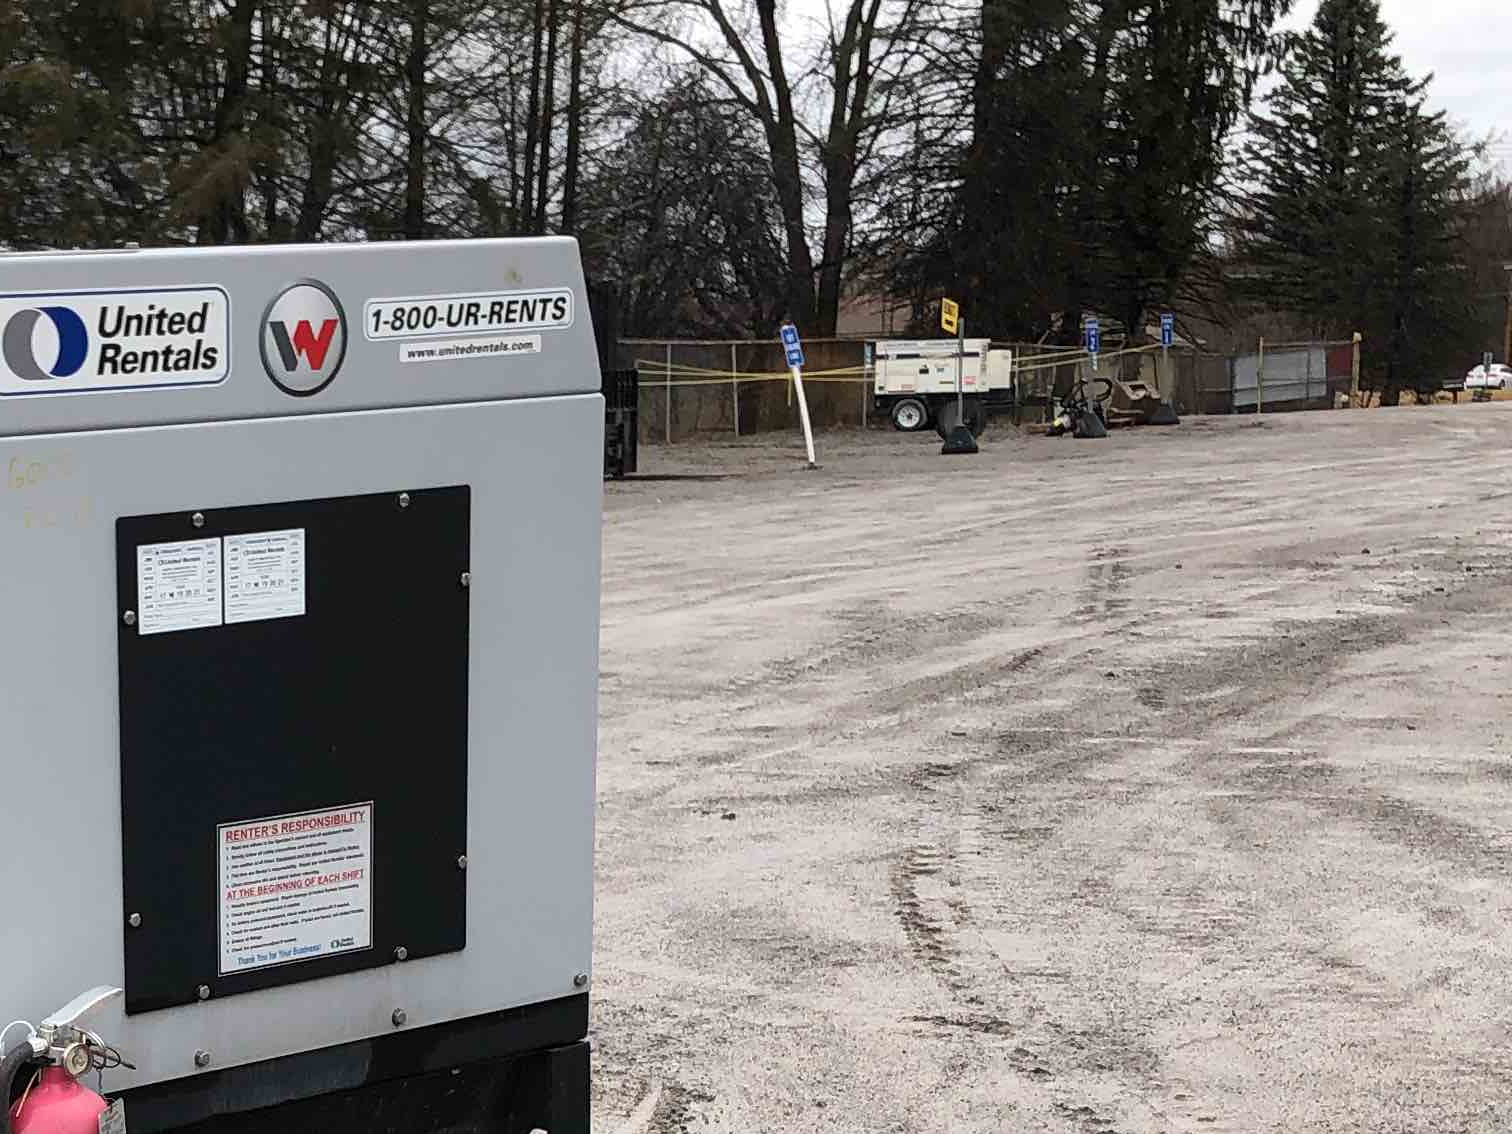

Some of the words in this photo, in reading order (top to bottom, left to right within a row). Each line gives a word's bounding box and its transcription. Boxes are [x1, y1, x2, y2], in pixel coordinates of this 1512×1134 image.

[97, 302, 209, 339] United
[371, 297, 567, 332] 1-800-UR-RENTS
[97, 340, 219, 376] Rentals
[407, 341, 534, 359] www.unitedrentals.com
[225, 823, 279, 842] RENTER'S
[280, 810, 366, 833] RESPONSIBILITY
[238, 885, 258, 898] THE
